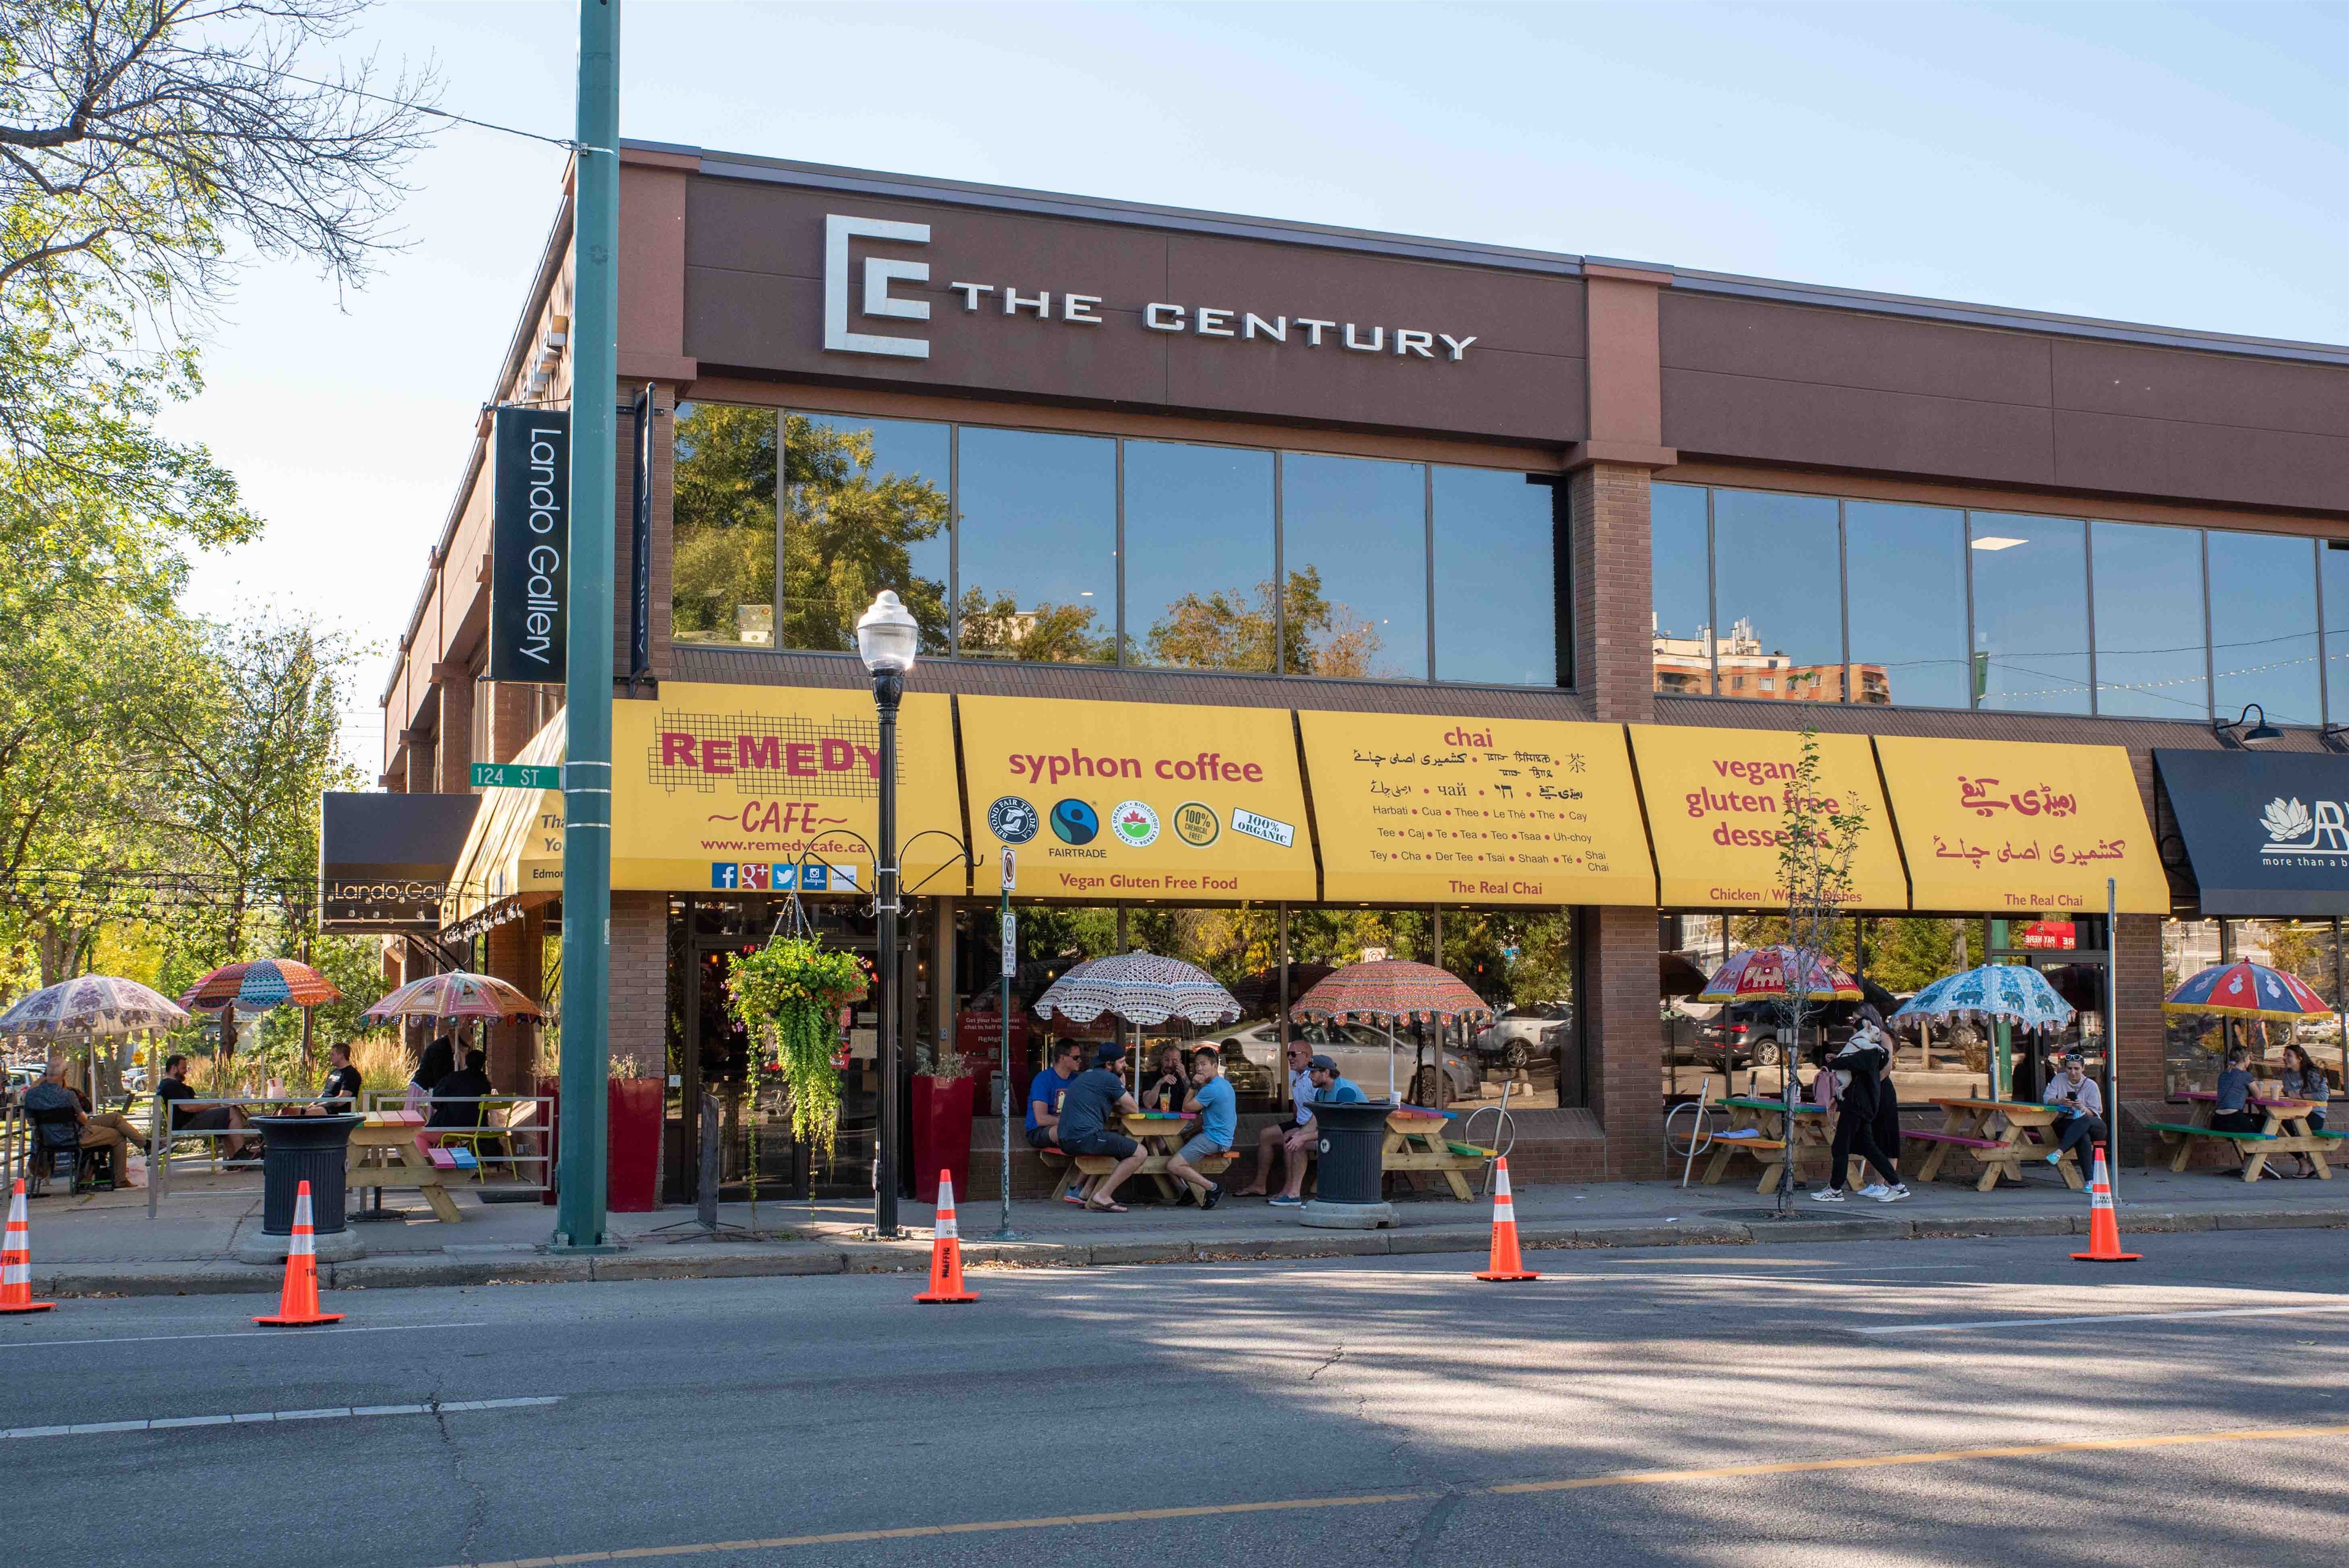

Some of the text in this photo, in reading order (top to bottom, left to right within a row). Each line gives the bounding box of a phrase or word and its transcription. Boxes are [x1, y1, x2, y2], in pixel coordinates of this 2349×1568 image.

[949, 281, 1478, 361] THE CENTURY
[519, 428, 562, 665] Lando Gallery
[1444, 726, 1494, 748] chai
[662, 732, 880, 779] REMEDY
[1565, 752, 1586, 774] 茶
[1009, 748, 1264, 784] syphon coffee
[1713, 759, 1797, 786] vegan
[477, 767, 540, 784] 124 ST
[1438, 782, 1468, 797] чай
[999, 799, 1018, 808] FAIR
[1686, 786, 1841, 818] gluten free
[742, 800, 819, 834] CAFE
[1185, 809, 1211, 828] 100%
[1248, 814, 1279, 832] 100%
[1373, 805, 1587, 823] Harbati Cua Thee Le Thé The Cay
[991, 808, 1008, 839] BEYOND
[1113, 803, 1132, 844] CANADA ORGANIC
[1134, 802, 1159, 845] BIOLOGIQUE CANADA
[1184, 823, 1208, 835] CHEMICAL
[2310, 800, 2349, 852] AR
[1189, 832, 1203, 841] FREE!
[1238, 822, 1287, 844] ORGANIC
[1377, 828, 1592, 844] Tee Caj Te Tea Teo Tsaa Uh-choy
[1713, 822, 1831, 849] desses
[700, 839, 866, 853] www.remedycafe.ca
[1049, 848, 1107, 858] FAIRTRADE
[1370, 850, 1606, 864] Tey Cha Der Tee Tsai Shaah Té Shai
[2263, 858, 2292, 866] more
[2298, 857, 2325, 866] than
[1588, 862, 1609, 872] Chai
[335, 883, 399, 899] Lando
[1059, 874, 1238, 891] Vegan Gluten Free Food
[1449, 880, 1543, 896] The Real Chai
[1710, 888, 1760, 901] Chicken
[2005, 894, 2083, 907] The Real Chai
